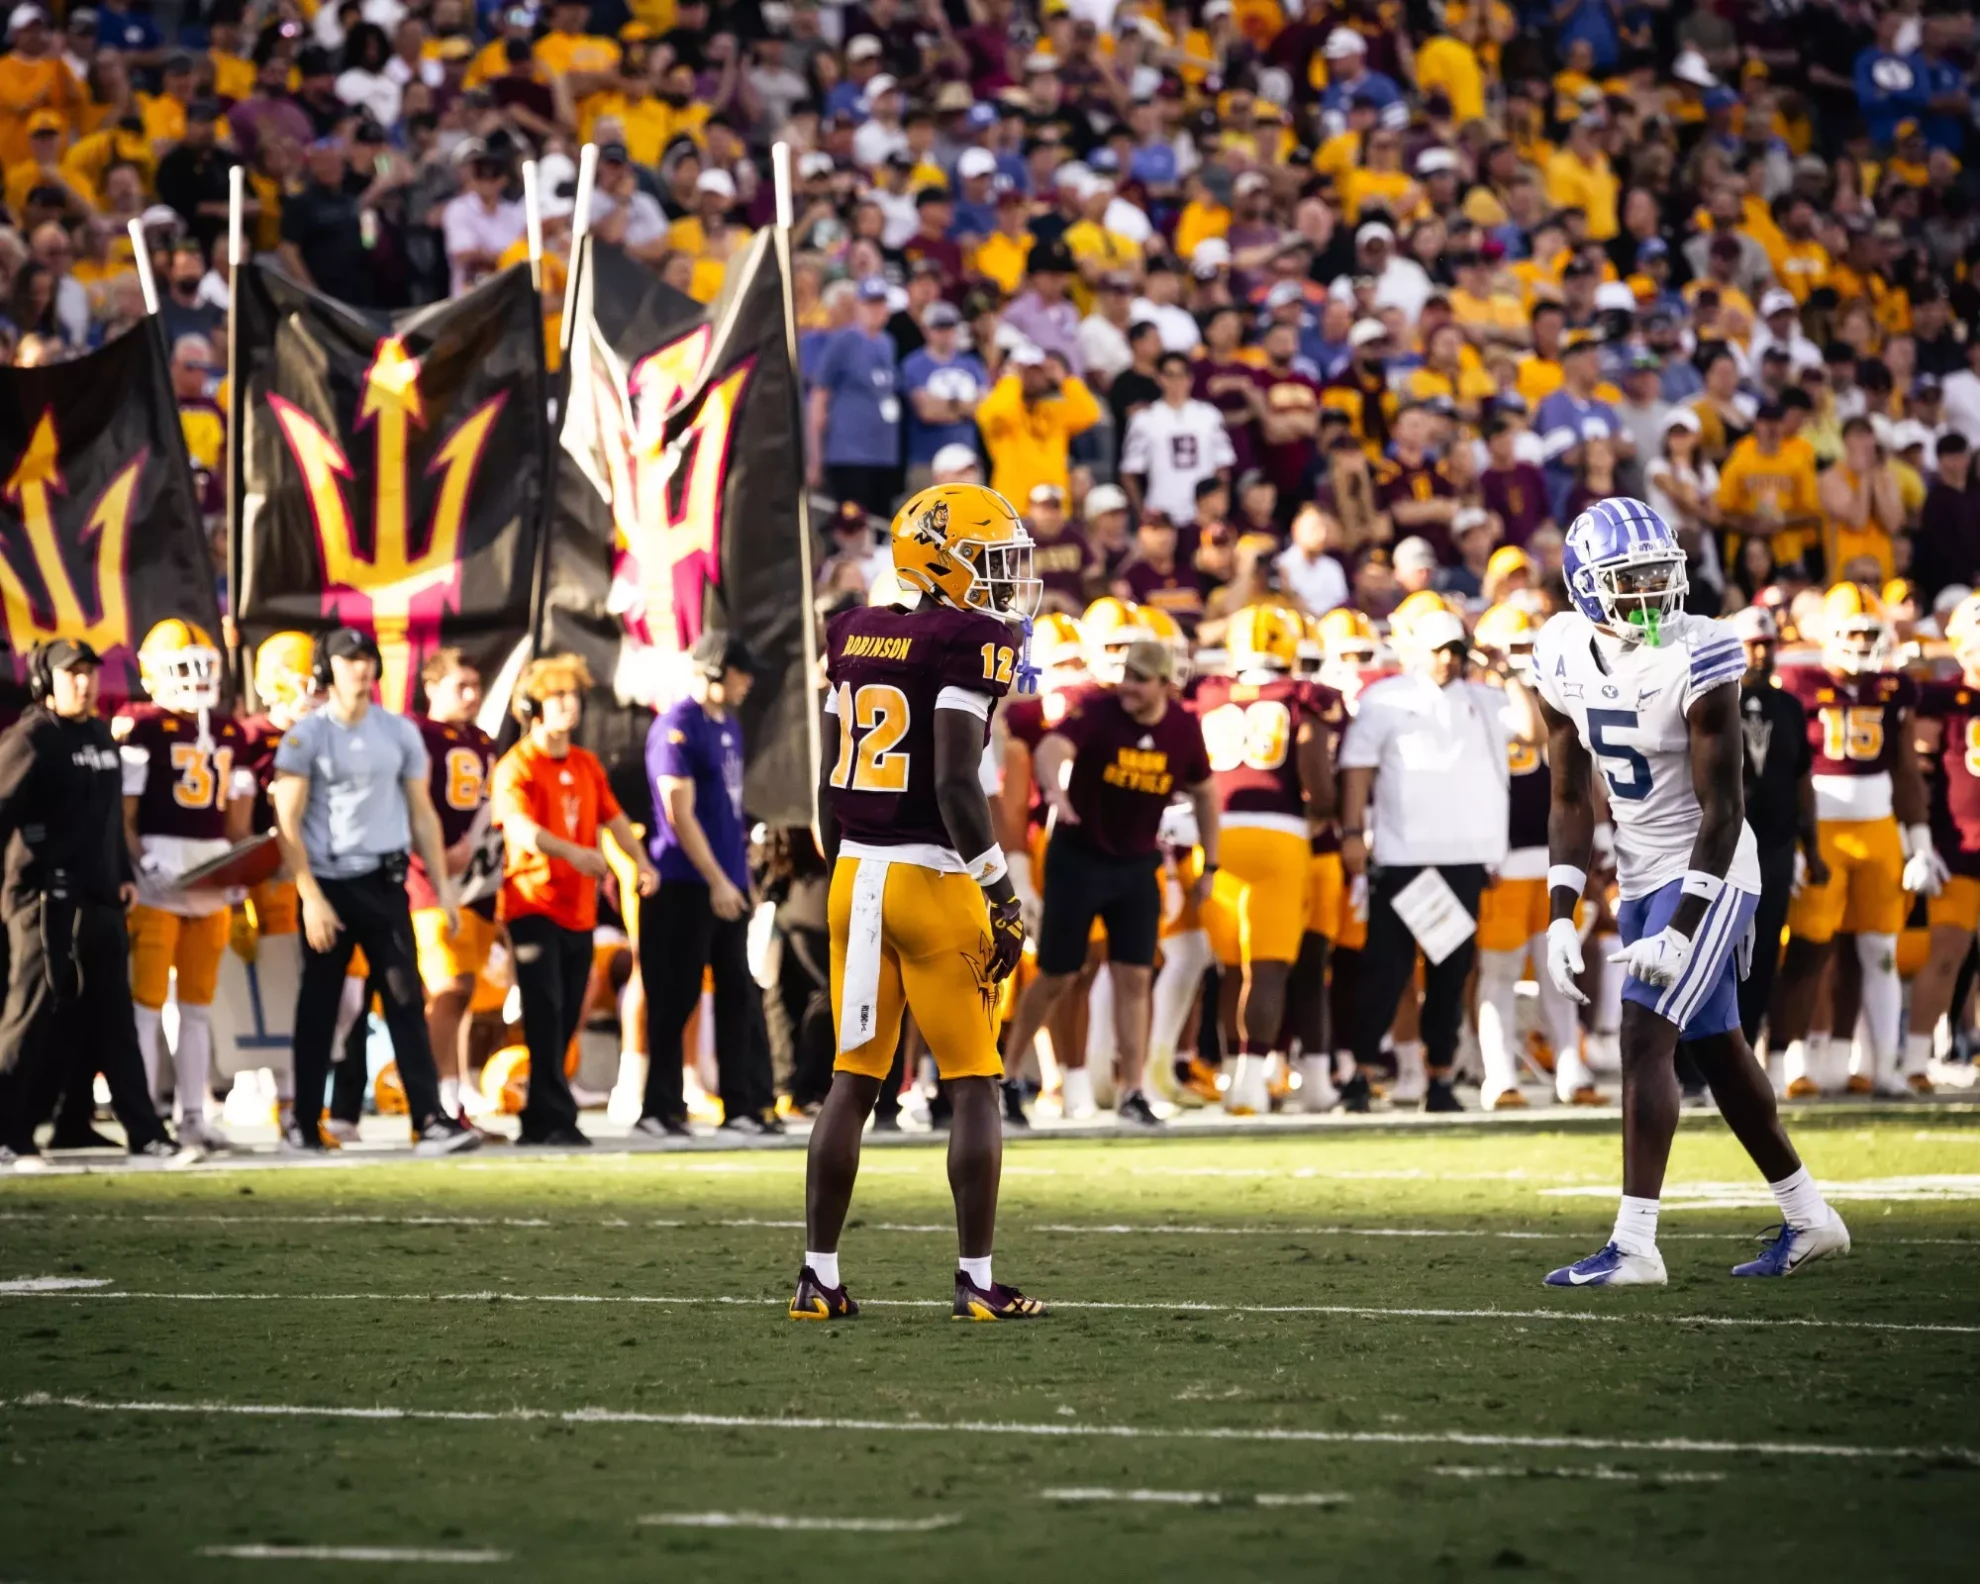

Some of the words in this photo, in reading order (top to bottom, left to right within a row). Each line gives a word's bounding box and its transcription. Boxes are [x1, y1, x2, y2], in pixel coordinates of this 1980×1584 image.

[841, 634, 913, 661] ROBINSON
[980, 643, 1014, 684] 12
[1555, 654, 1567, 677] A
[830, 681, 911, 792] 12
[1586, 707, 1654, 801] 5
[1818, 706, 1885, 761] 15
[170, 741, 234, 812] 31
